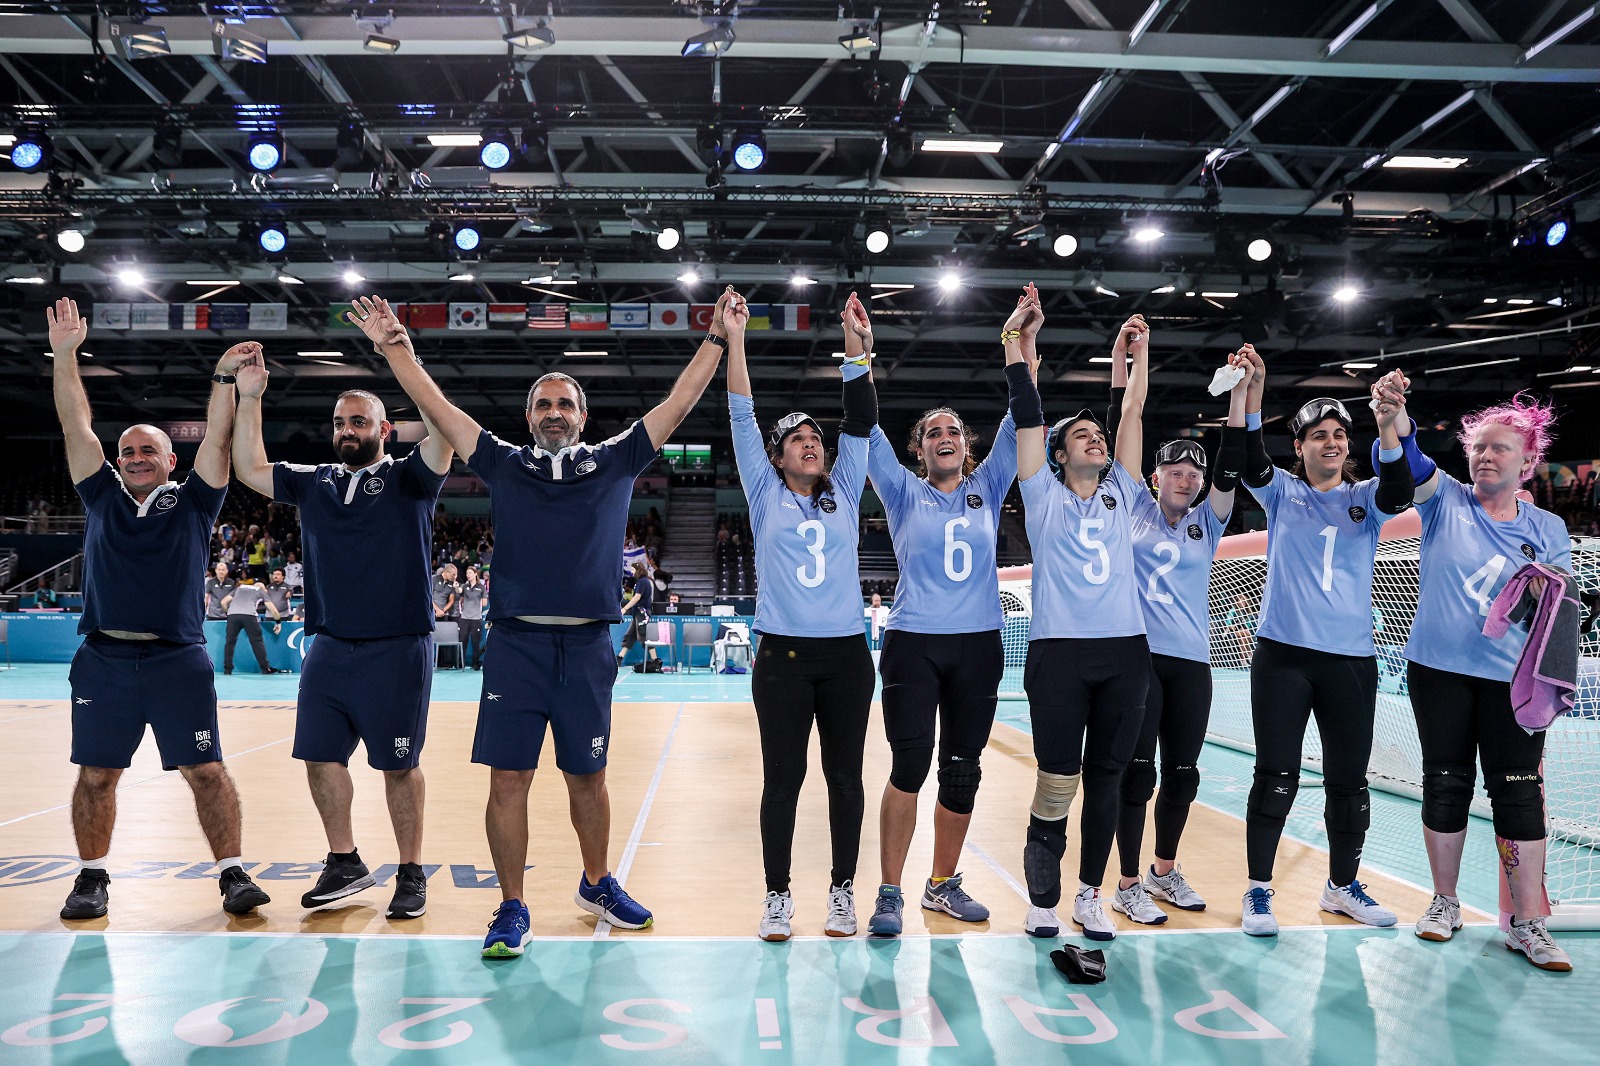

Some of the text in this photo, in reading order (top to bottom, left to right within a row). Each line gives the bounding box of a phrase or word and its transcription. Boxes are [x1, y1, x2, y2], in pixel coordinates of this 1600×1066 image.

[796, 520, 826, 587] 3
[944, 517, 973, 582] 6
[1079, 518, 1111, 586] 5
[1146, 541, 1180, 605] 2
[1319, 525, 1338, 592] 1
[1463, 554, 1506, 617] 4
[109, 861, 535, 889] Allanz
